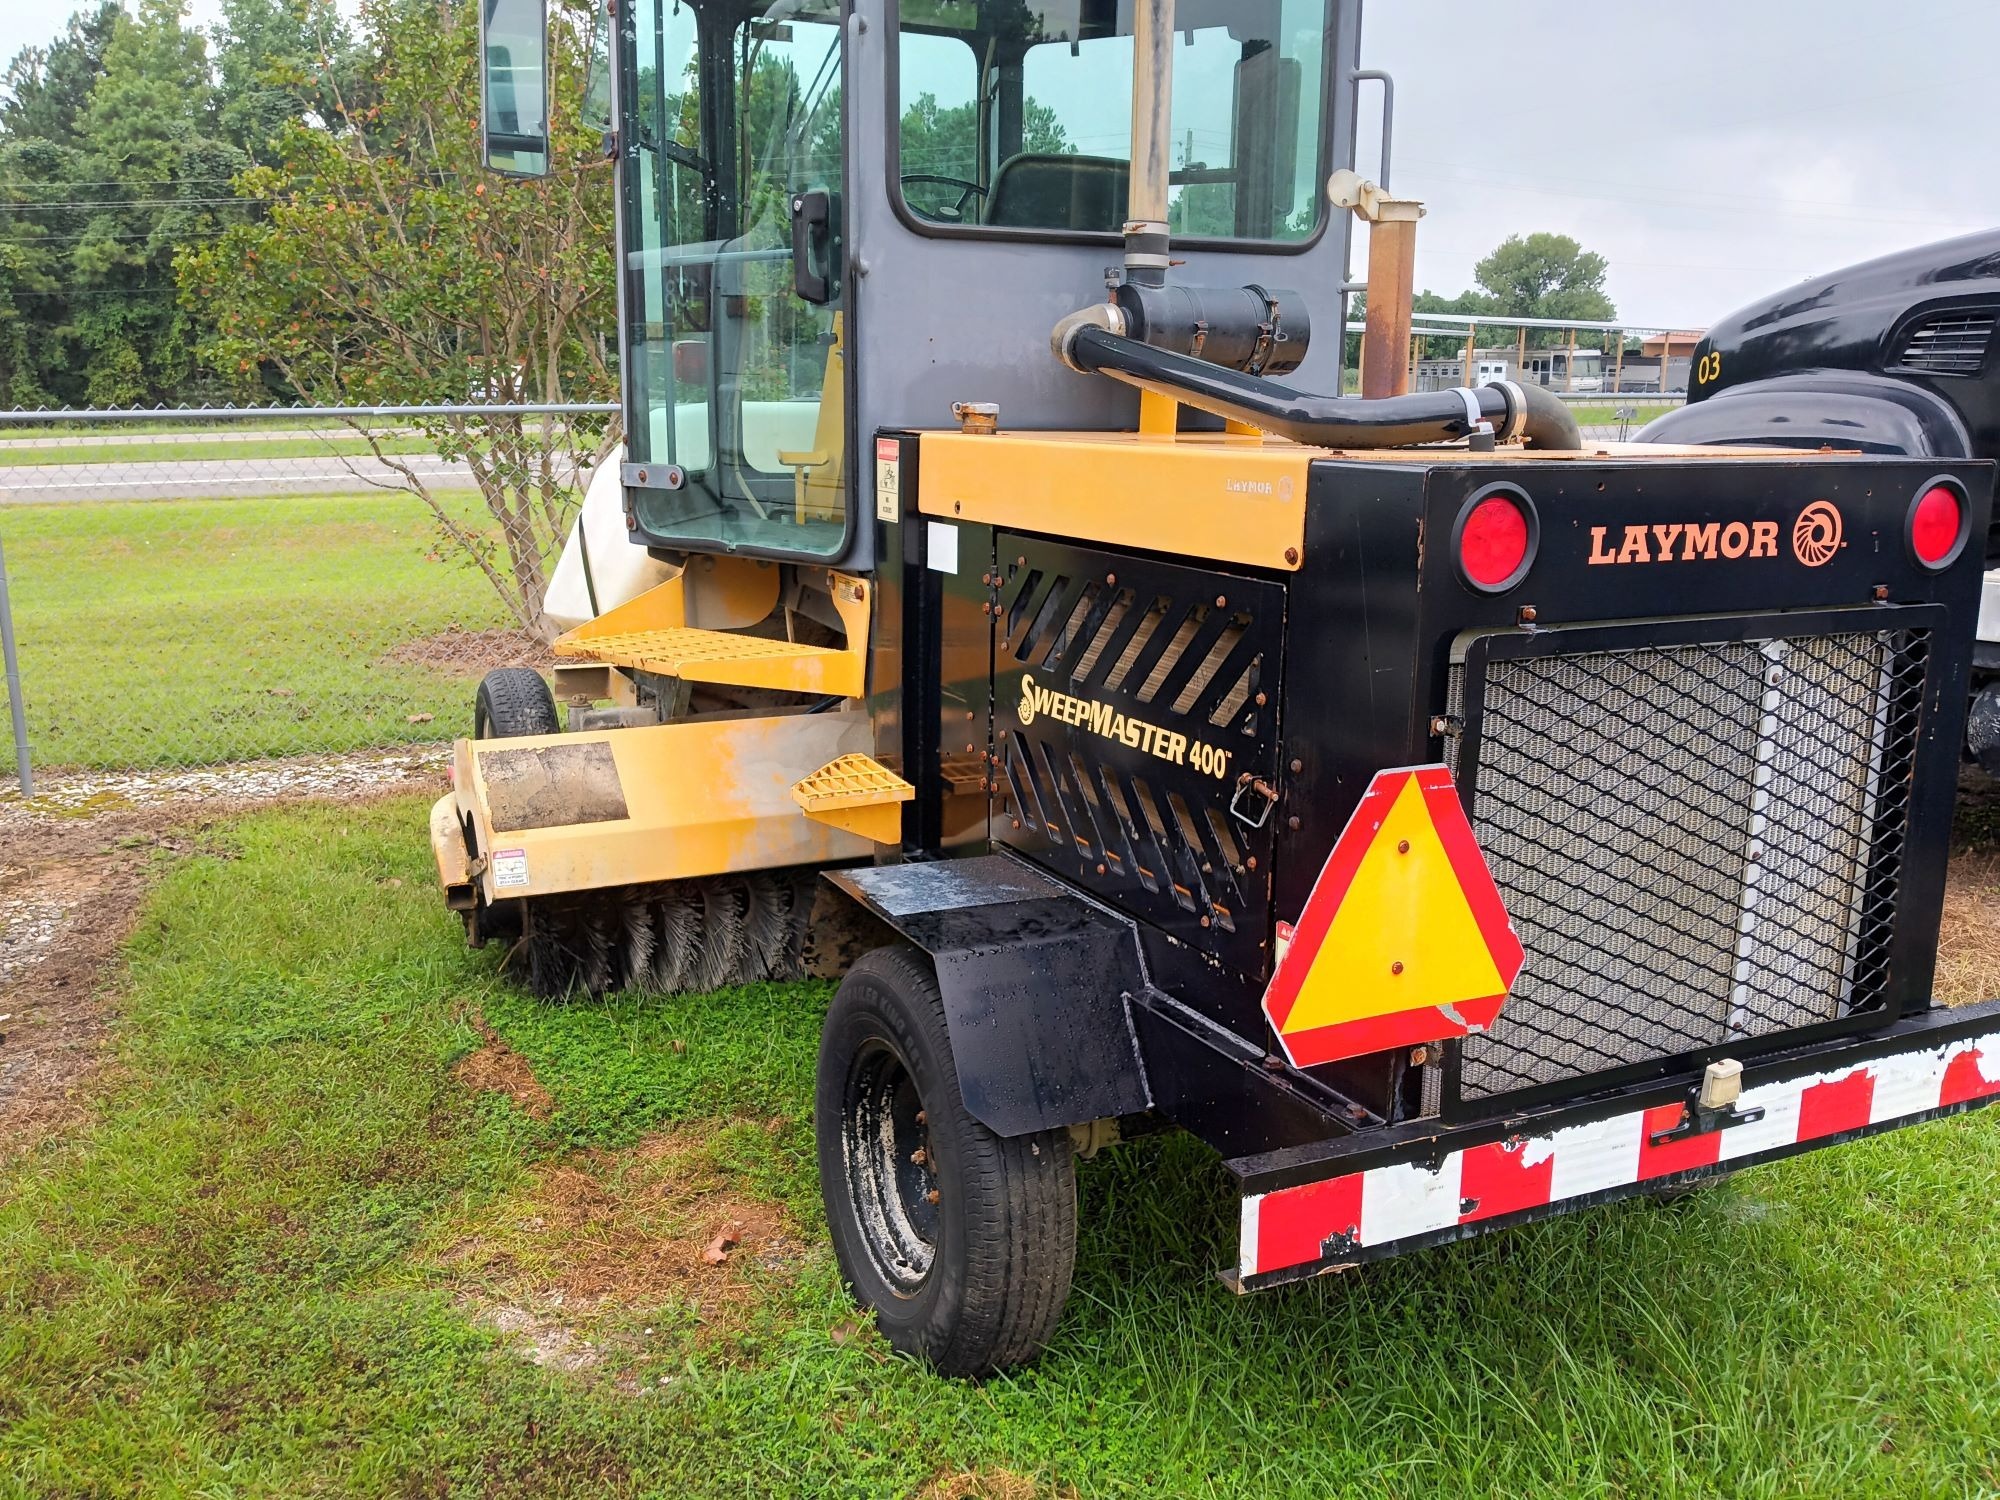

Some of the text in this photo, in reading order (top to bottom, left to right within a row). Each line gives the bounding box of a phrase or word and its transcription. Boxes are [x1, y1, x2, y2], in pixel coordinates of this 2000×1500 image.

[1698, 351, 1720, 385] 03
[1226, 478, 1272, 495] LAYMOR
[1587, 521, 1779, 565] LAYMOR
